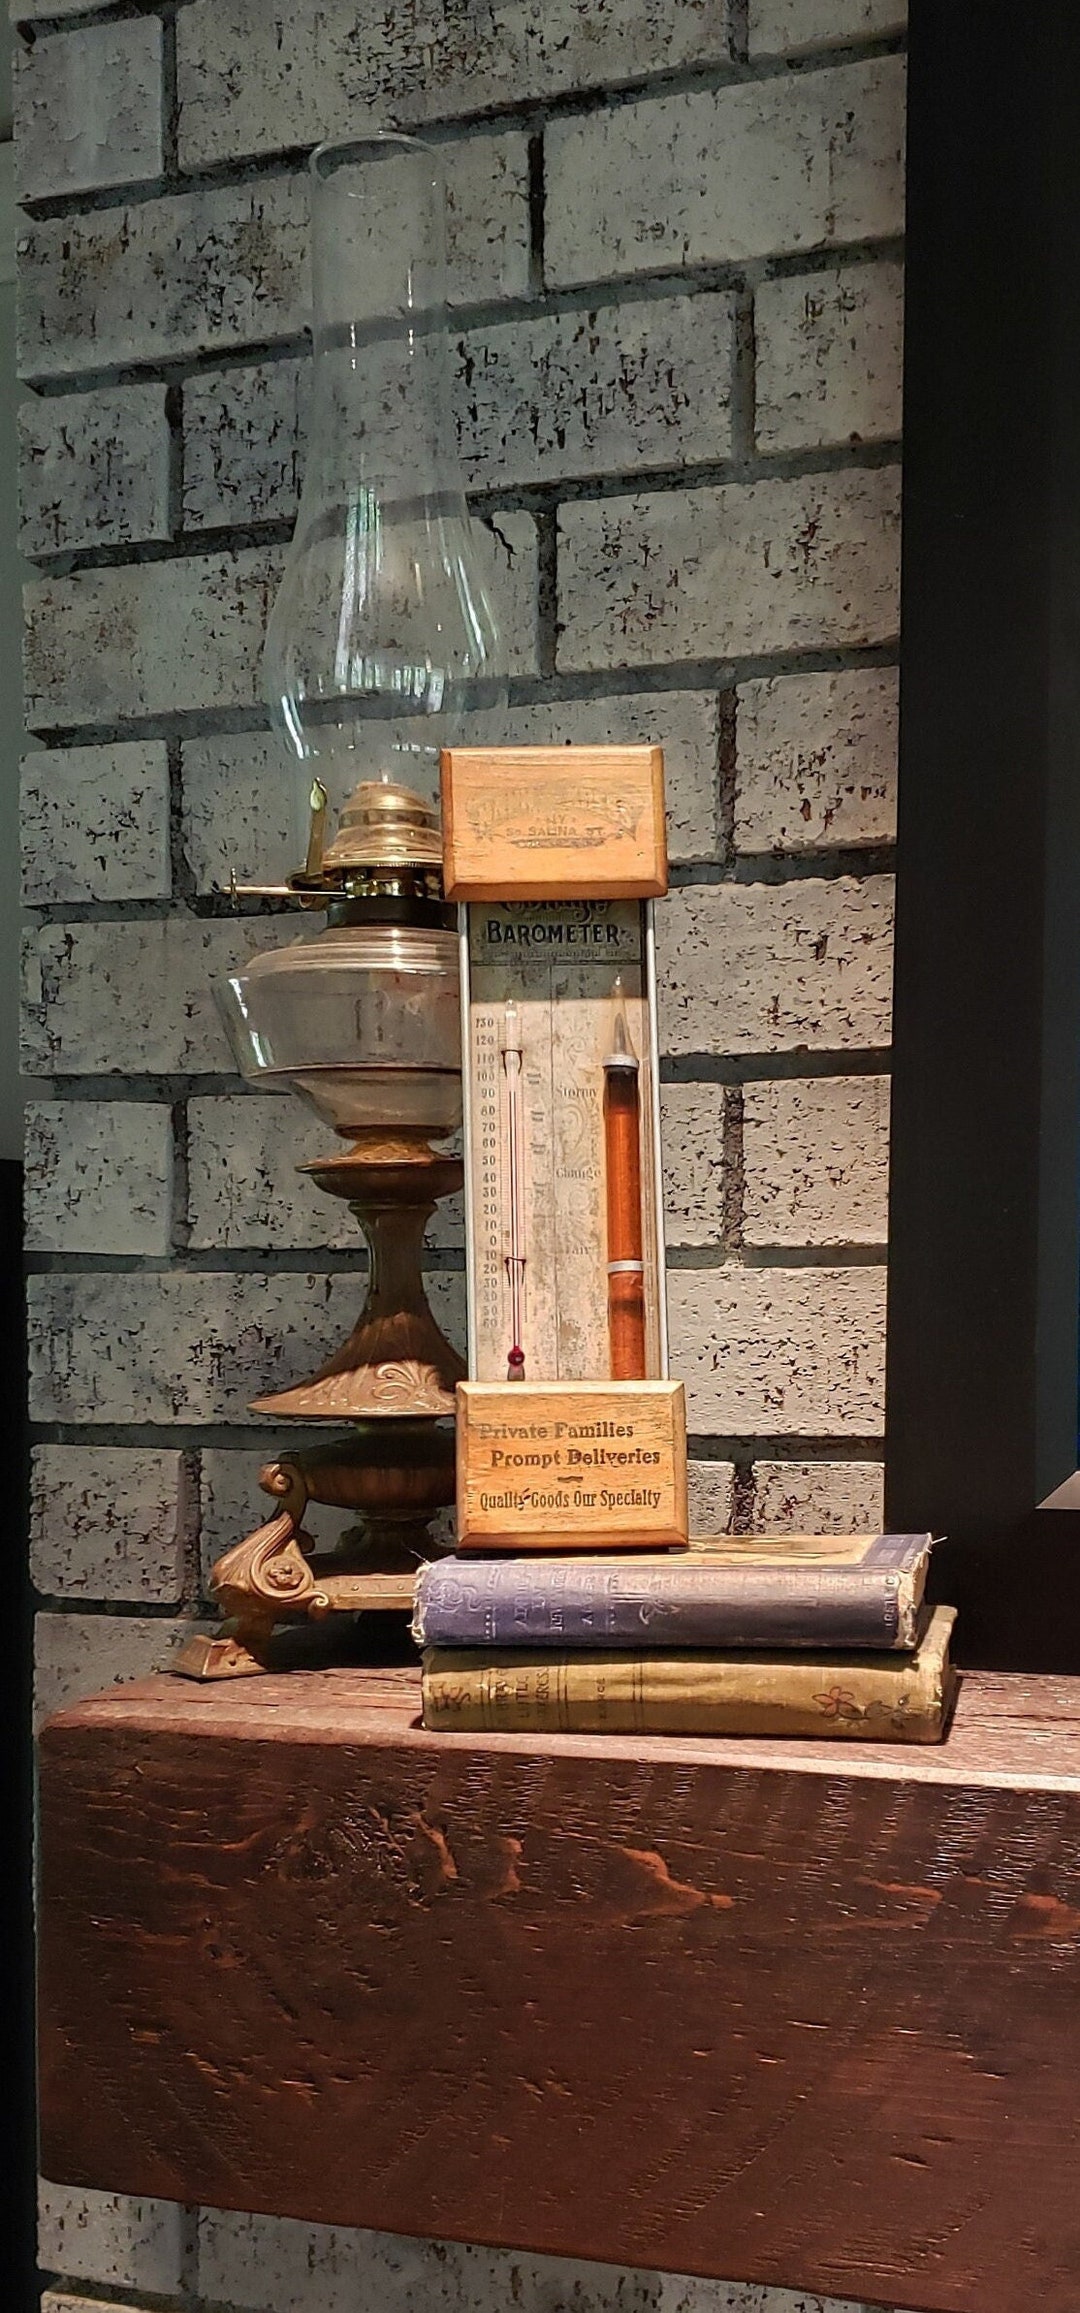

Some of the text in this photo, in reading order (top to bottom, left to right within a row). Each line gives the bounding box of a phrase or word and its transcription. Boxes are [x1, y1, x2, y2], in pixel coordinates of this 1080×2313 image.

[486, 919, 621, 947] BAROMETER
[476, 1018, 494, 1029] 130
[476, 1035, 494, 1046] 120
[477, 1053, 495, 1065] 110
[477, 1071, 495, 1081] 100
[481, 1087, 495, 1099] 90
[481, 1105, 496, 1116] 80
[482, 1122, 496, 1132] 70
[482, 1138, 496, 1148] 60
[482, 1155, 496, 1166] 50
[483, 1172, 497, 1183] 40
[556, 1167, 602, 1181] Change
[483, 1187, 497, 1198] 30
[483, 1203, 497, 1215] 20
[485, 1220, 497, 1231] 10
[489, 1235, 497, 1246] 0
[485, 1250, 497, 1261] 10
[483, 1264, 498, 1274] 20
[484, 1278, 498, 1289] 30
[479, 1421, 634, 1440] Private Families
[491, 1448, 661, 1468] Prompt Deliveries
[481, 1489, 662, 1511] Quality Goods Our Specialty
